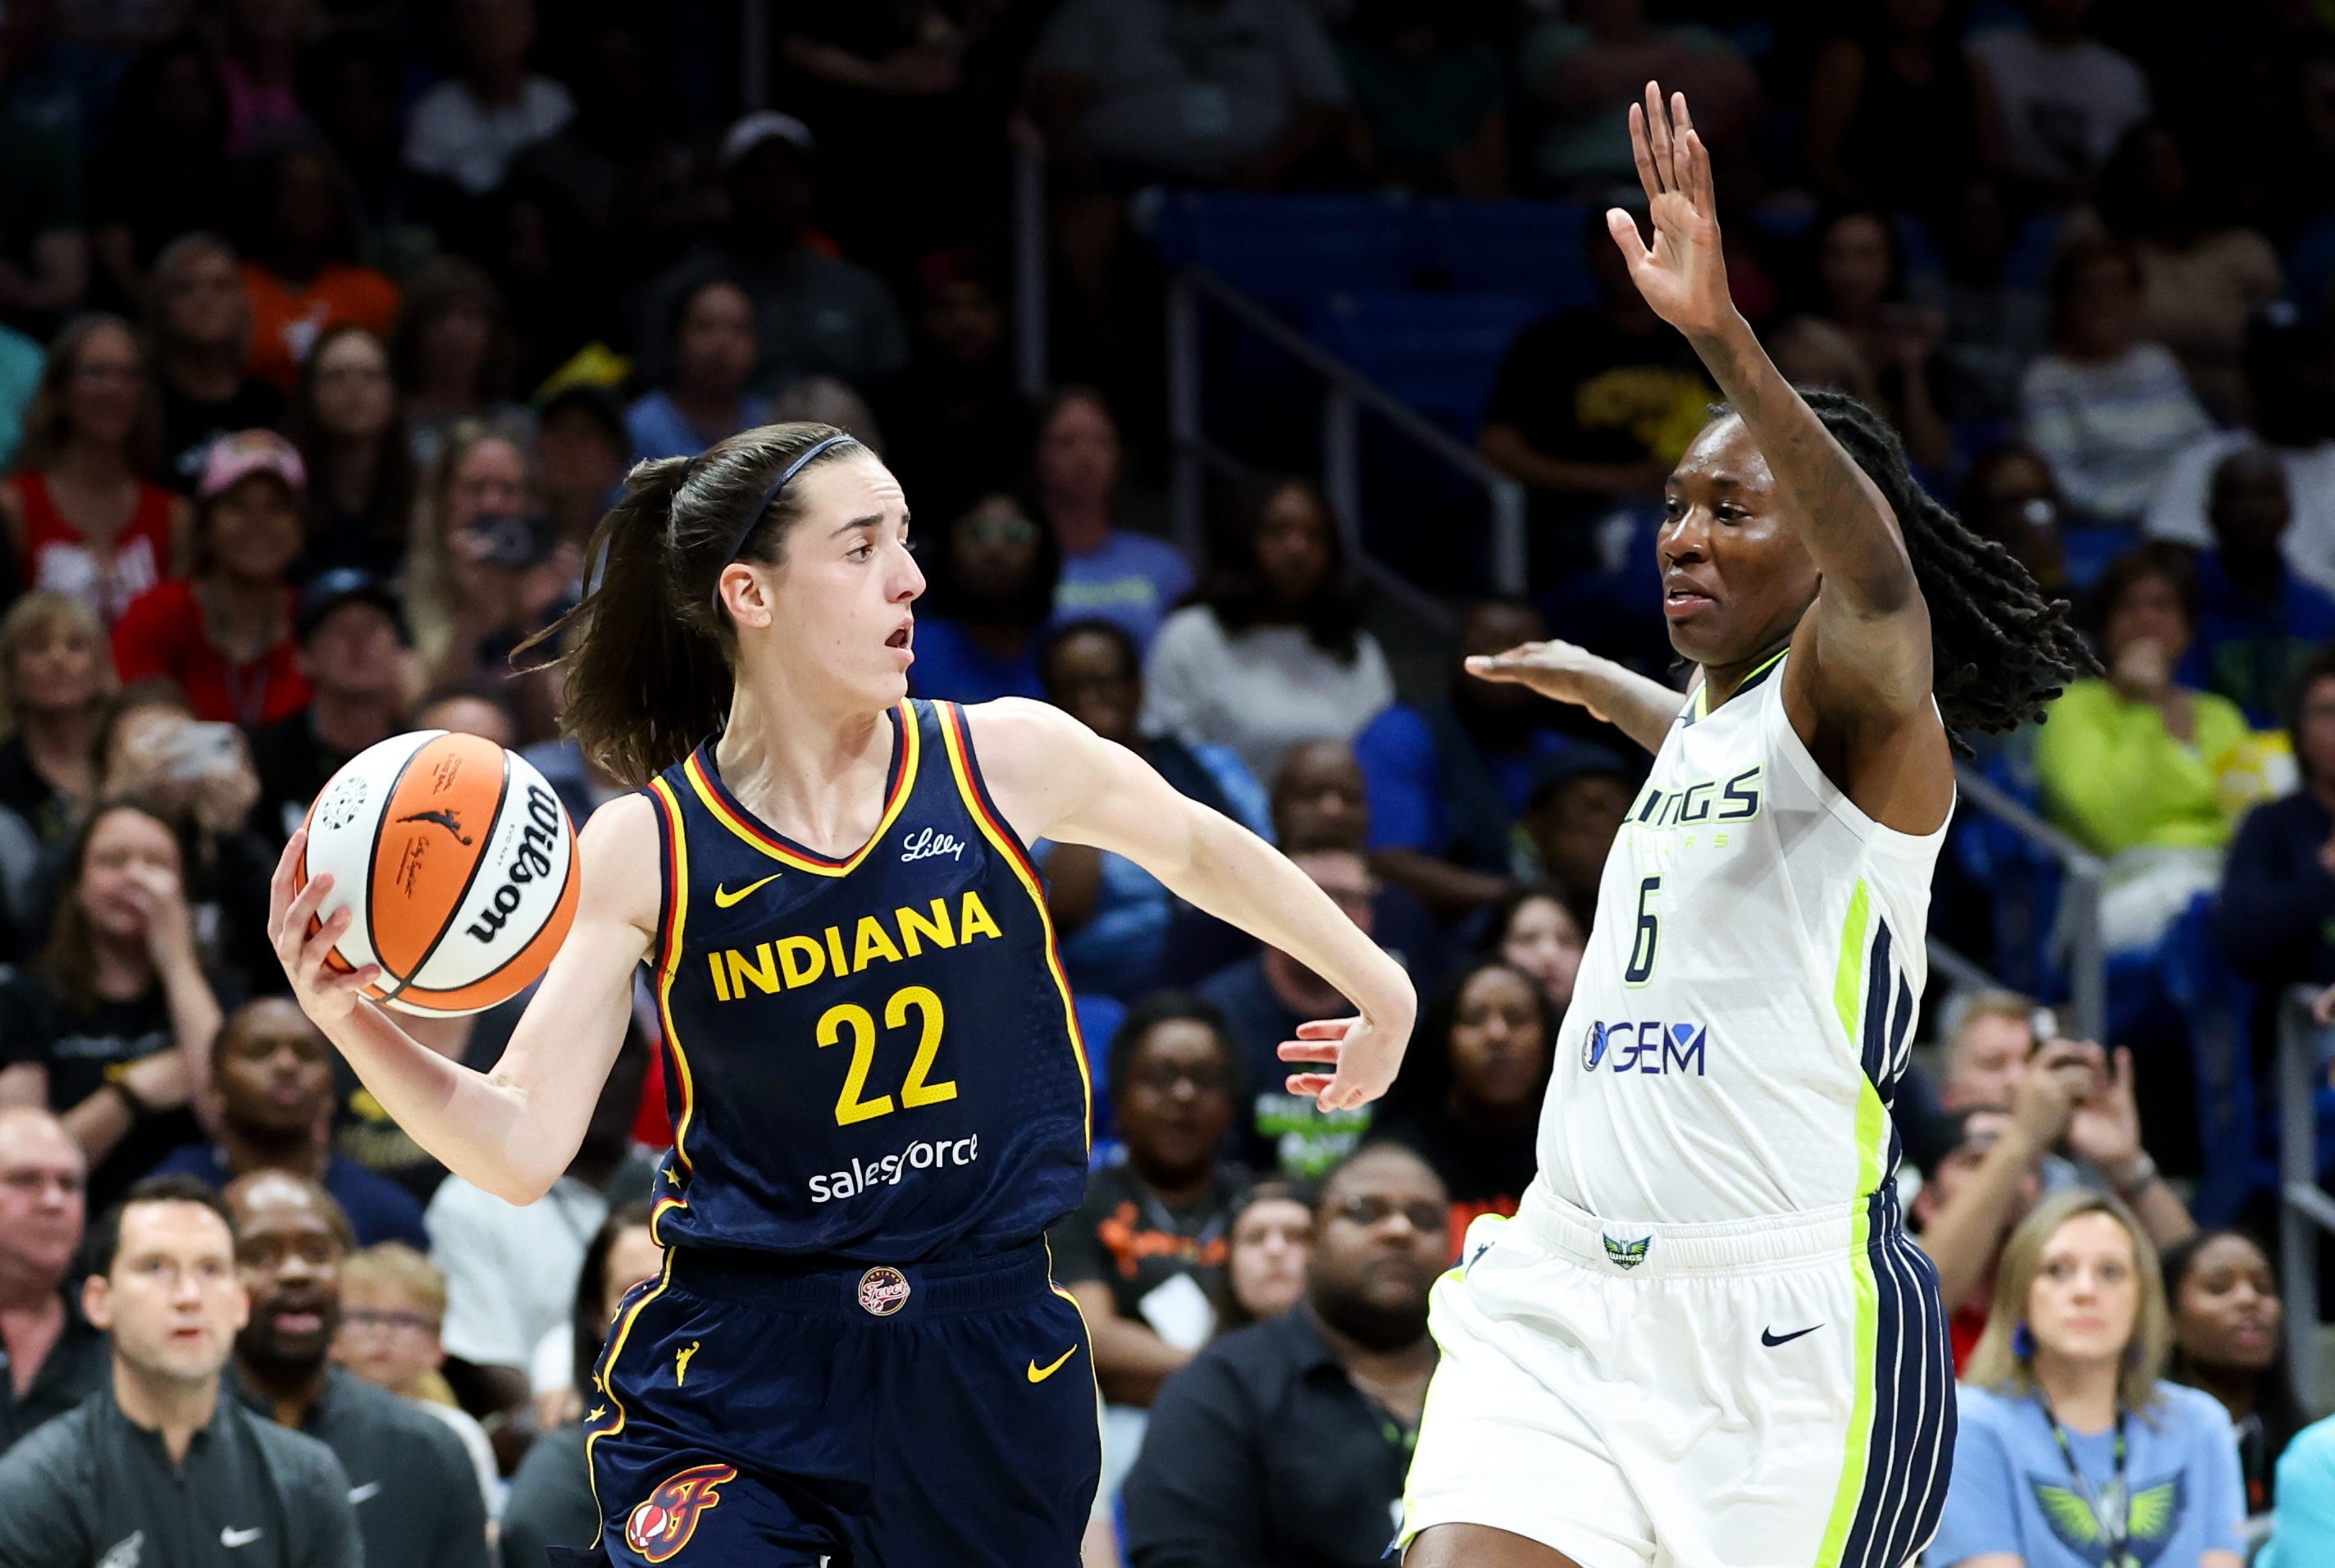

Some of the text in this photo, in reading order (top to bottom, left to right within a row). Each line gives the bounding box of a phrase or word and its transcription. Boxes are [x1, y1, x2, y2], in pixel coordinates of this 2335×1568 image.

[1621, 762, 1765, 830] INGS
[465, 783, 559, 944] Wilson
[901, 827, 965, 862] Lilly
[708, 891, 1002, 1001] INDIANA
[1625, 873, 1663, 988] 6
[815, 986, 958, 1126] 22
[1606, 1021, 1707, 1077] GEM
[809, 1133, 978, 1203] salesforce
[1609, 1251, 1644, 1262] WINGS
[861, 1279, 910, 1306] Fever
